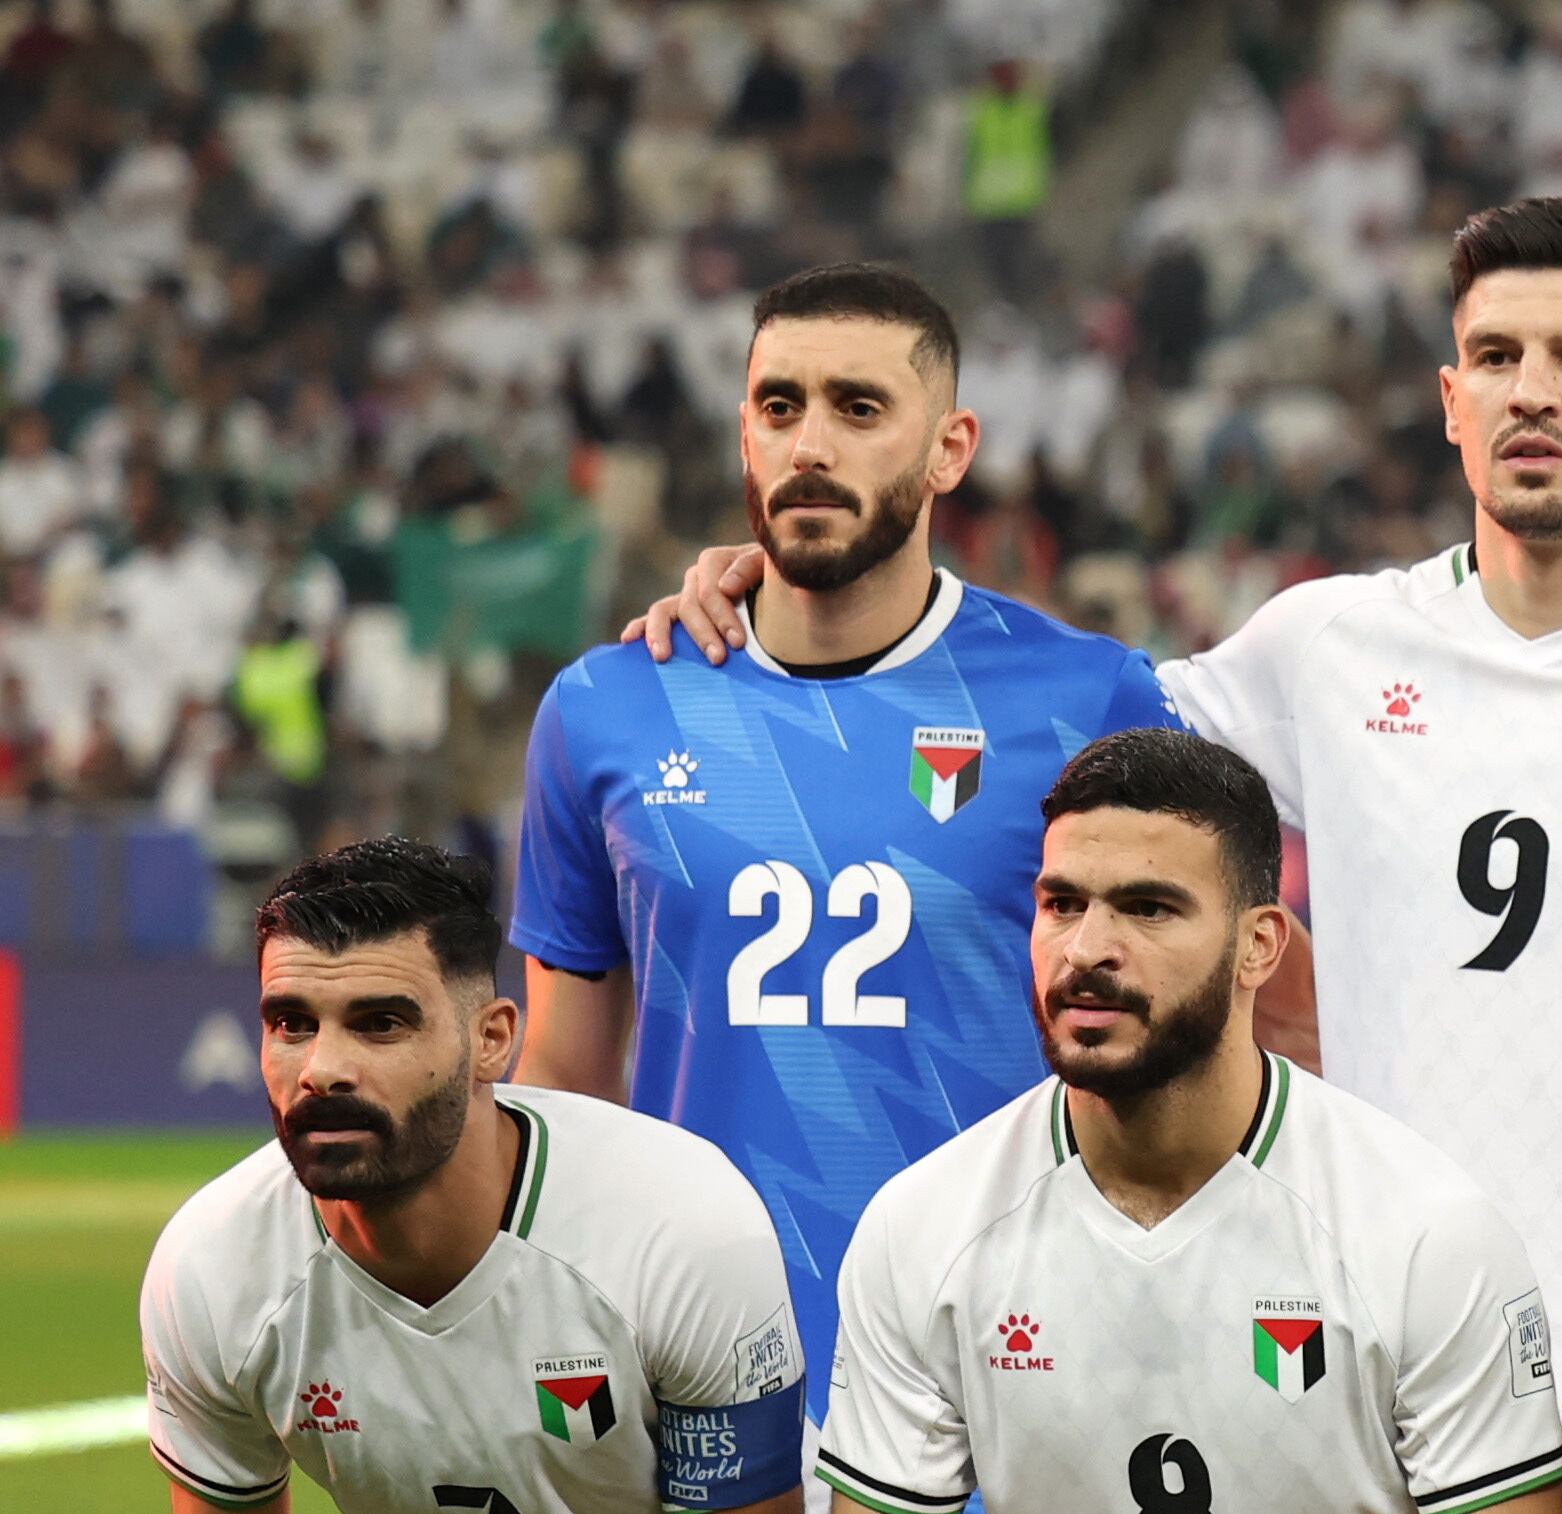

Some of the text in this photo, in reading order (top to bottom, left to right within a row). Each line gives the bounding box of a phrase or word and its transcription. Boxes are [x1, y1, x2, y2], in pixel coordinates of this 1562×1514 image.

[1366, 719, 1428, 735] KELME
[918, 732, 979, 743] PALESTINE
[643, 790, 707, 806] KELME
[1456, 809, 1550, 973] 9
[727, 860, 913, 1028] 22
[1255, 1300, 1321, 1313] PALESTINE
[535, 1357, 605, 1373] PALESTINE
[989, 1356, 1055, 1371] KELME
[662, 1427, 737, 1457] NITES
[676, 1457, 745, 1480] World
[671, 1484, 706, 1499] FIFA
